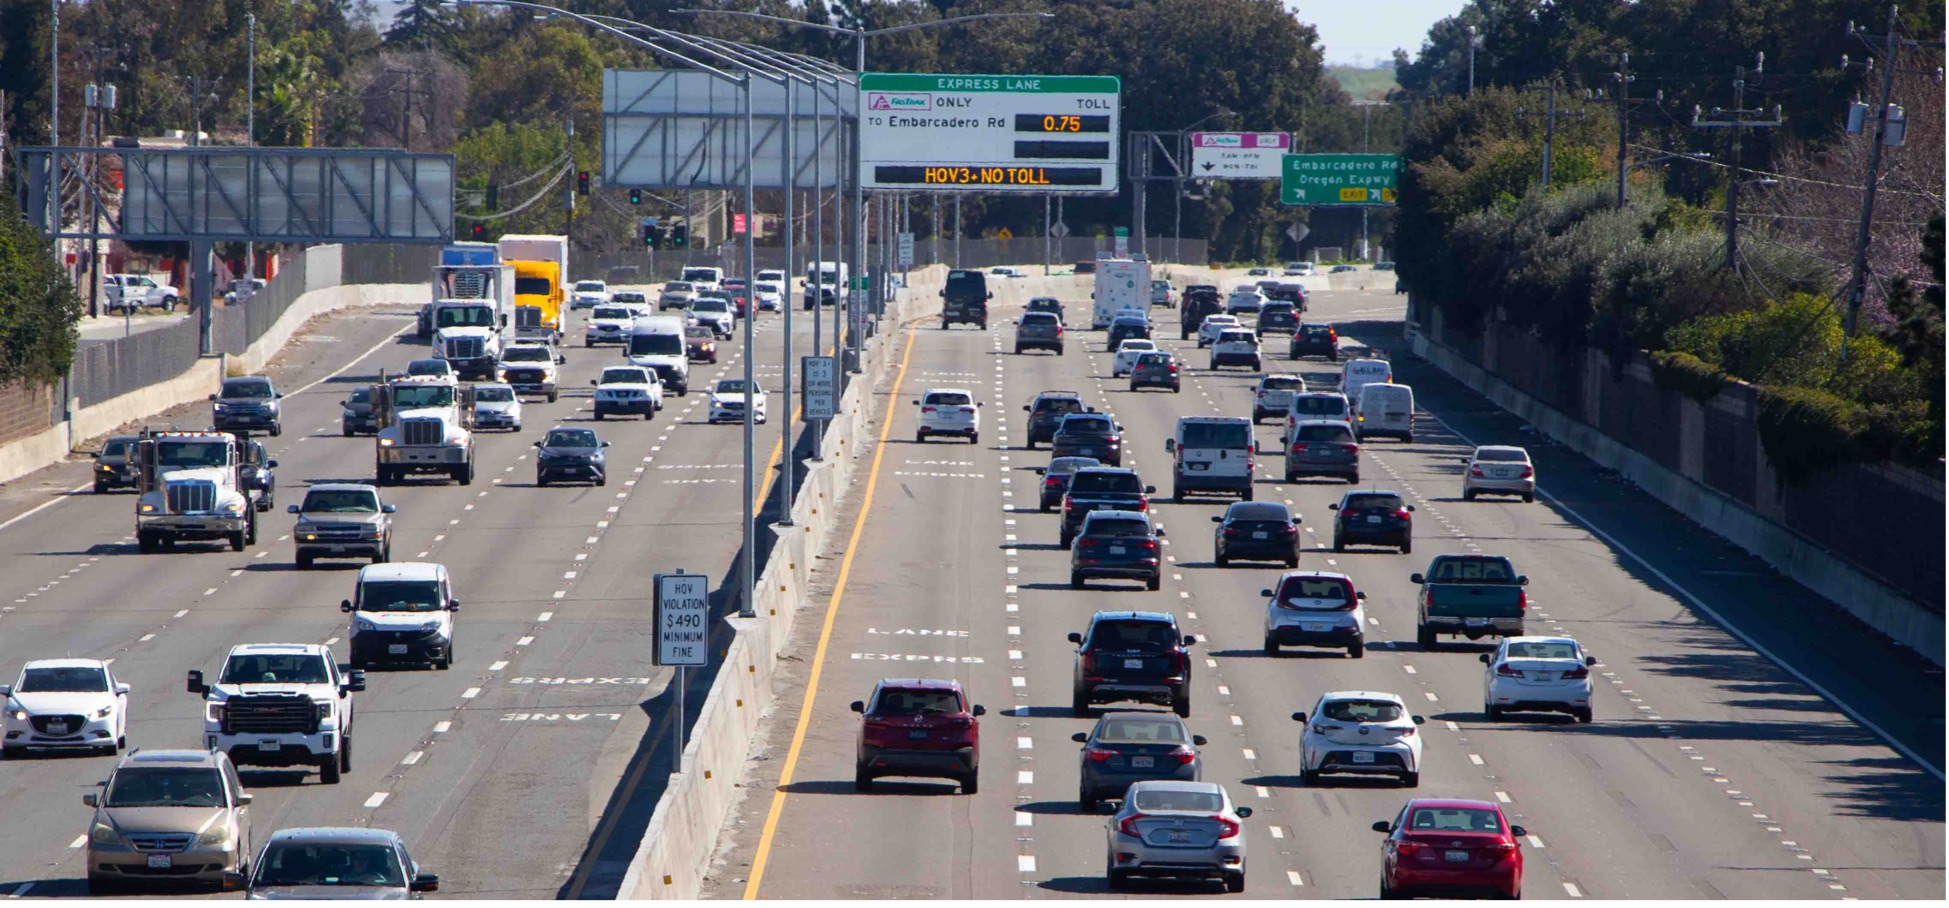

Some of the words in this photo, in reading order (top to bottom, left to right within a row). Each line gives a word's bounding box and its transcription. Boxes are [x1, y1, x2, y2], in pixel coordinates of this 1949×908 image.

[938, 79, 999, 89] EXPRESS
[1006, 80, 1041, 90] LANE
[936, 97, 972, 107] ONLY
[1077, 99, 1110, 109] TOLL
[868, 117, 882, 126] TO
[889, 116, 979, 128] Embarcadero
[987, 117, 1005, 128] Rd
[1043, 116, 1081, 132] 0.75
[1293, 160, 1375, 170] Embarcadero
[1381, 160, 1398, 170] Rd
[925, 167, 978, 184] HOV3+
[981, 168, 1003, 184] NO
[1007, 168, 1050, 184] TOLL
[1300, 174, 1343, 187] Oregon
[675, 584, 693, 594] HOV
[663, 599, 705, 610] VIOLATION
[667, 614, 700, 629] $490
[664, 632, 703, 642] MINIMUM
[867, 627, 970, 637] LANE
[673, 647, 693, 658] FINE
[499, 713, 622, 721] LANE
